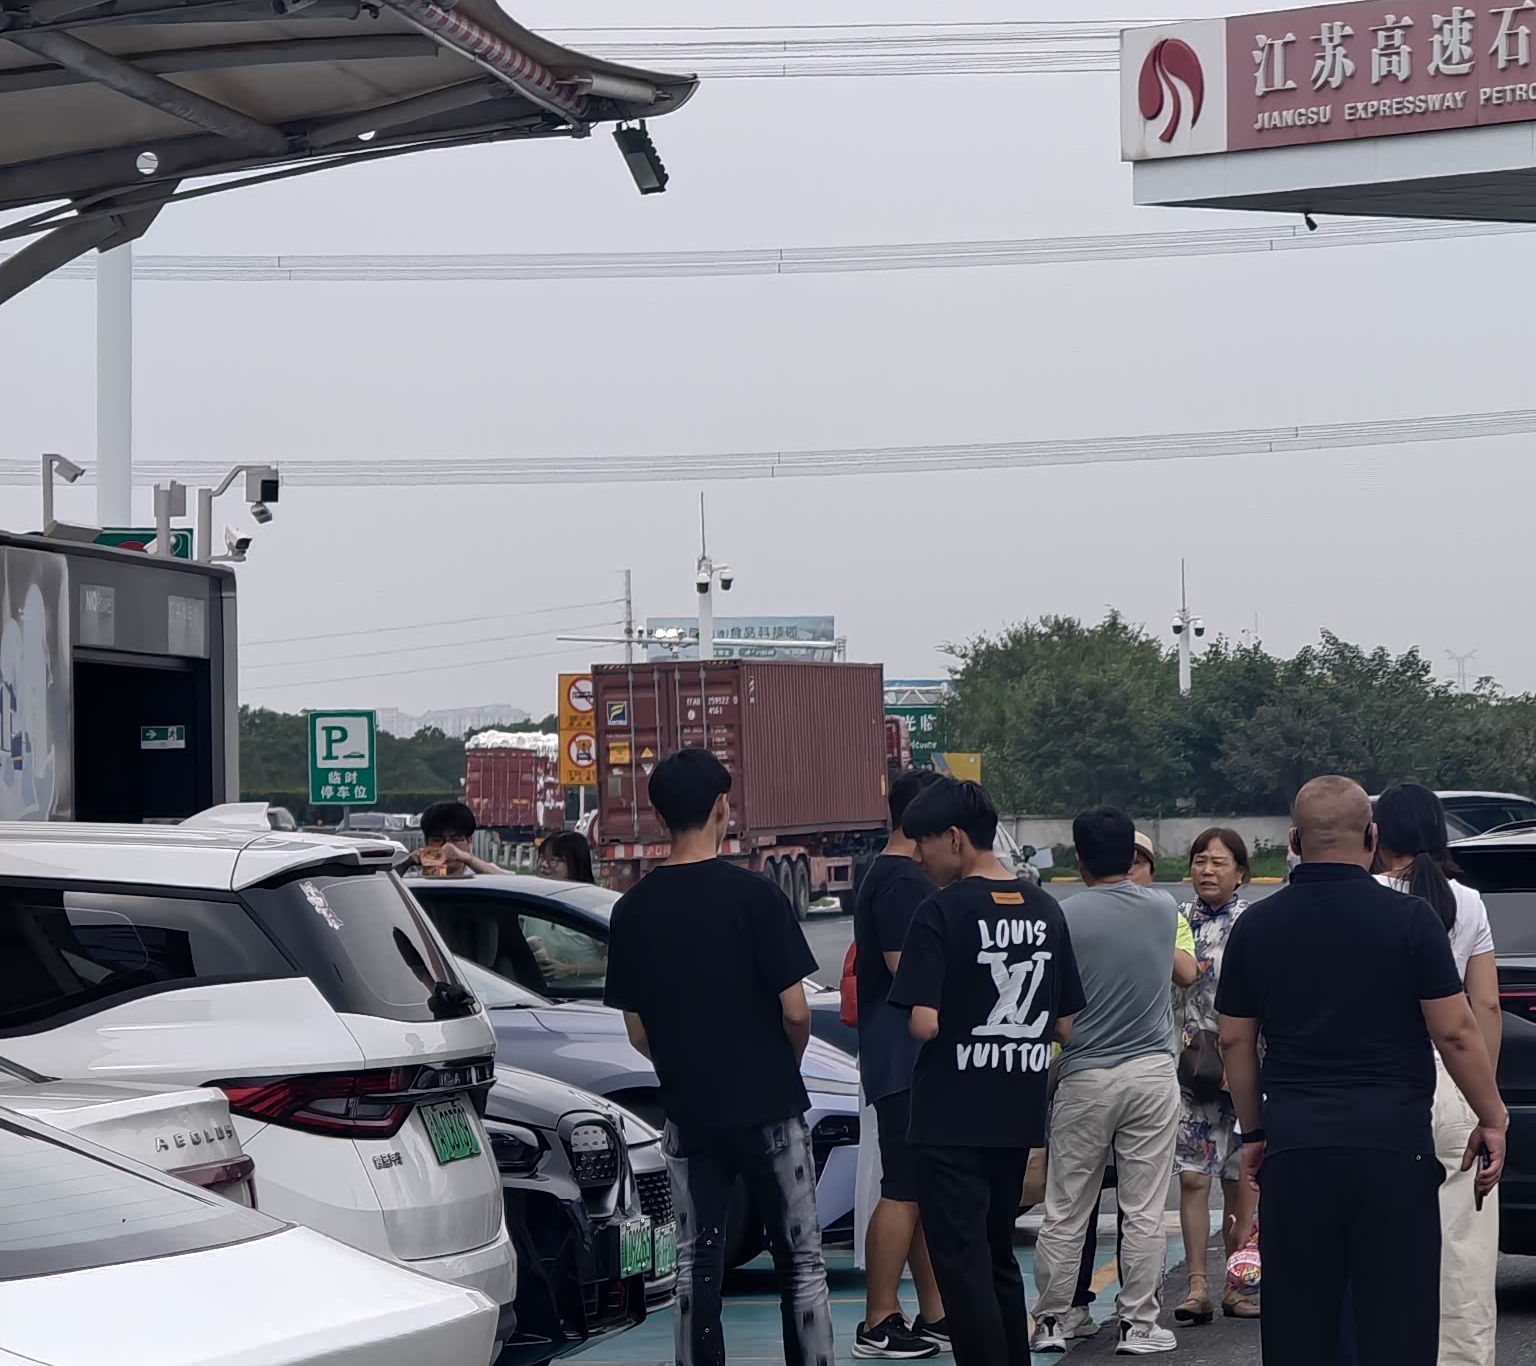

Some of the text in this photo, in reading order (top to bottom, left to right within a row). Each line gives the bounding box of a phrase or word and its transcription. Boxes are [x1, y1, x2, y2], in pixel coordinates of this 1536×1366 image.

[1253, 104, 1333, 130] JIANGSU
[1344, 90, 1466, 121] EXPRESSWAY
[321, 725, 348, 761] P
[320, 785, 367, 799] 停车位
[328, 771, 358, 784] 临时
[978, 918, 1047, 950] LOUIS
[155, 1124, 233, 1152] AEOLUS
